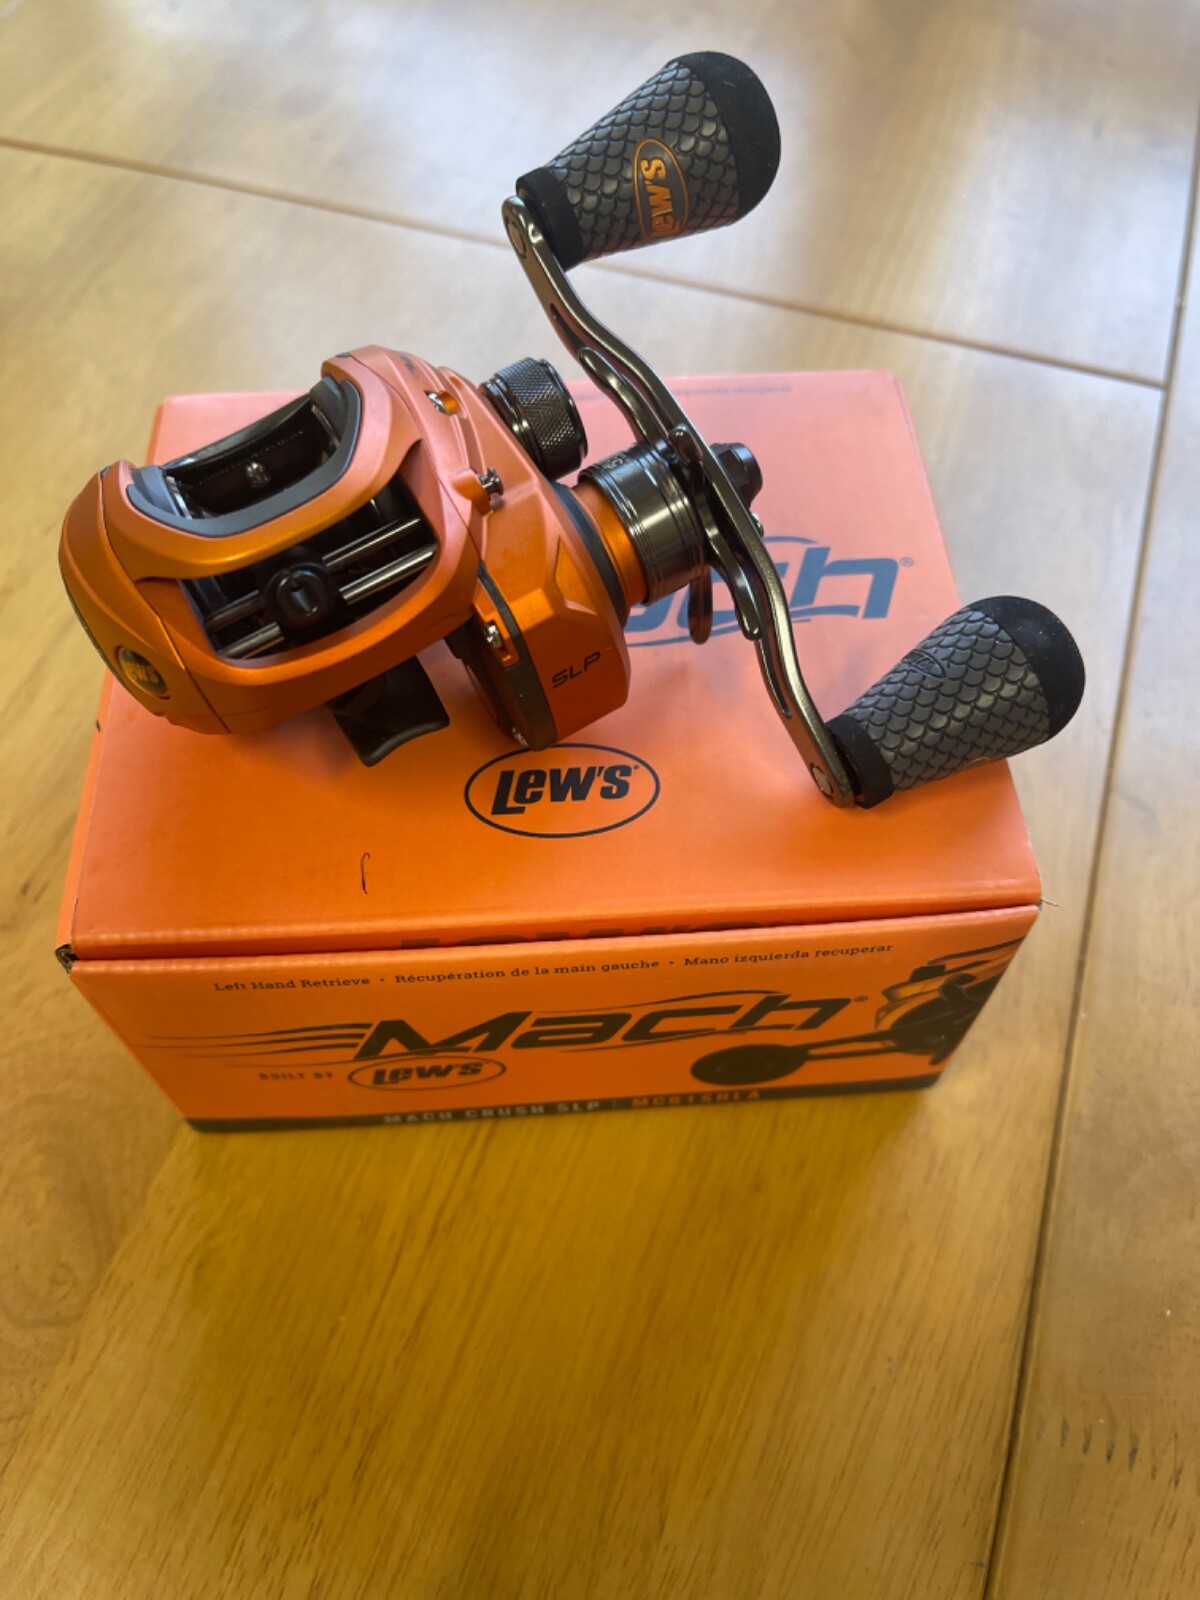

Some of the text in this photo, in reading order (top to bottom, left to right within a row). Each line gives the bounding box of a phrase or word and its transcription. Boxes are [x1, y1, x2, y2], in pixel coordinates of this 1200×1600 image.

[552, 652, 601, 689] SLP
[491, 765, 633, 815] Lew's
[214, 944, 893, 991] Left Hand Retrieve Récupération de la main gauche Mano izquierda recuperar
[371, 1061, 484, 1086] Lew's
[384, 1111, 453, 1124] MACH
[465, 1104, 545, 1119] CRUSH
[557, 1101, 600, 1113] SLP
